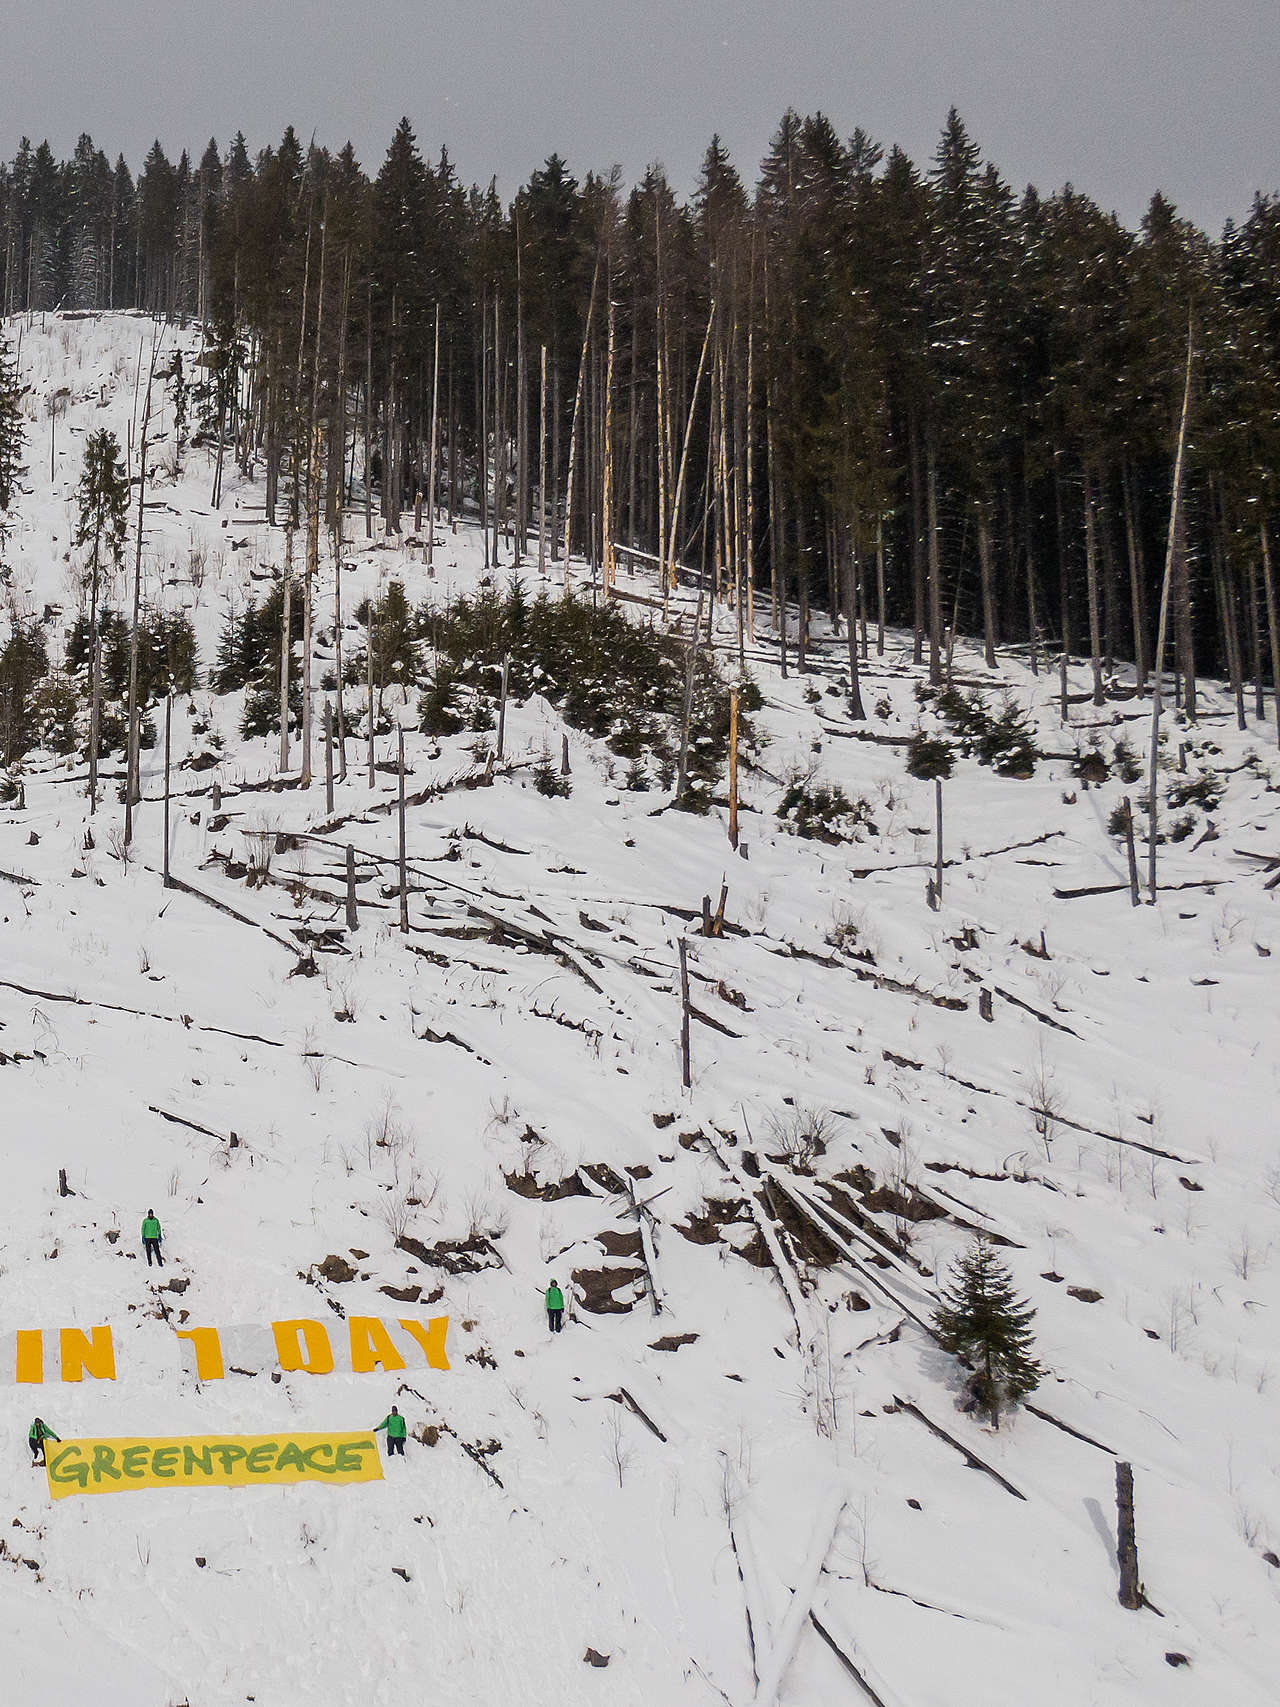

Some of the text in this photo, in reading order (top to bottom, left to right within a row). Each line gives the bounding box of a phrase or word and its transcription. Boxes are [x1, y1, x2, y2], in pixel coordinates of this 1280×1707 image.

[15, 1325, 117, 1384] IN
[176, 1327, 225, 1381] 1
[271, 1315, 451, 1375] DAY
[49, 1439, 375, 1488] GREENPEACE
